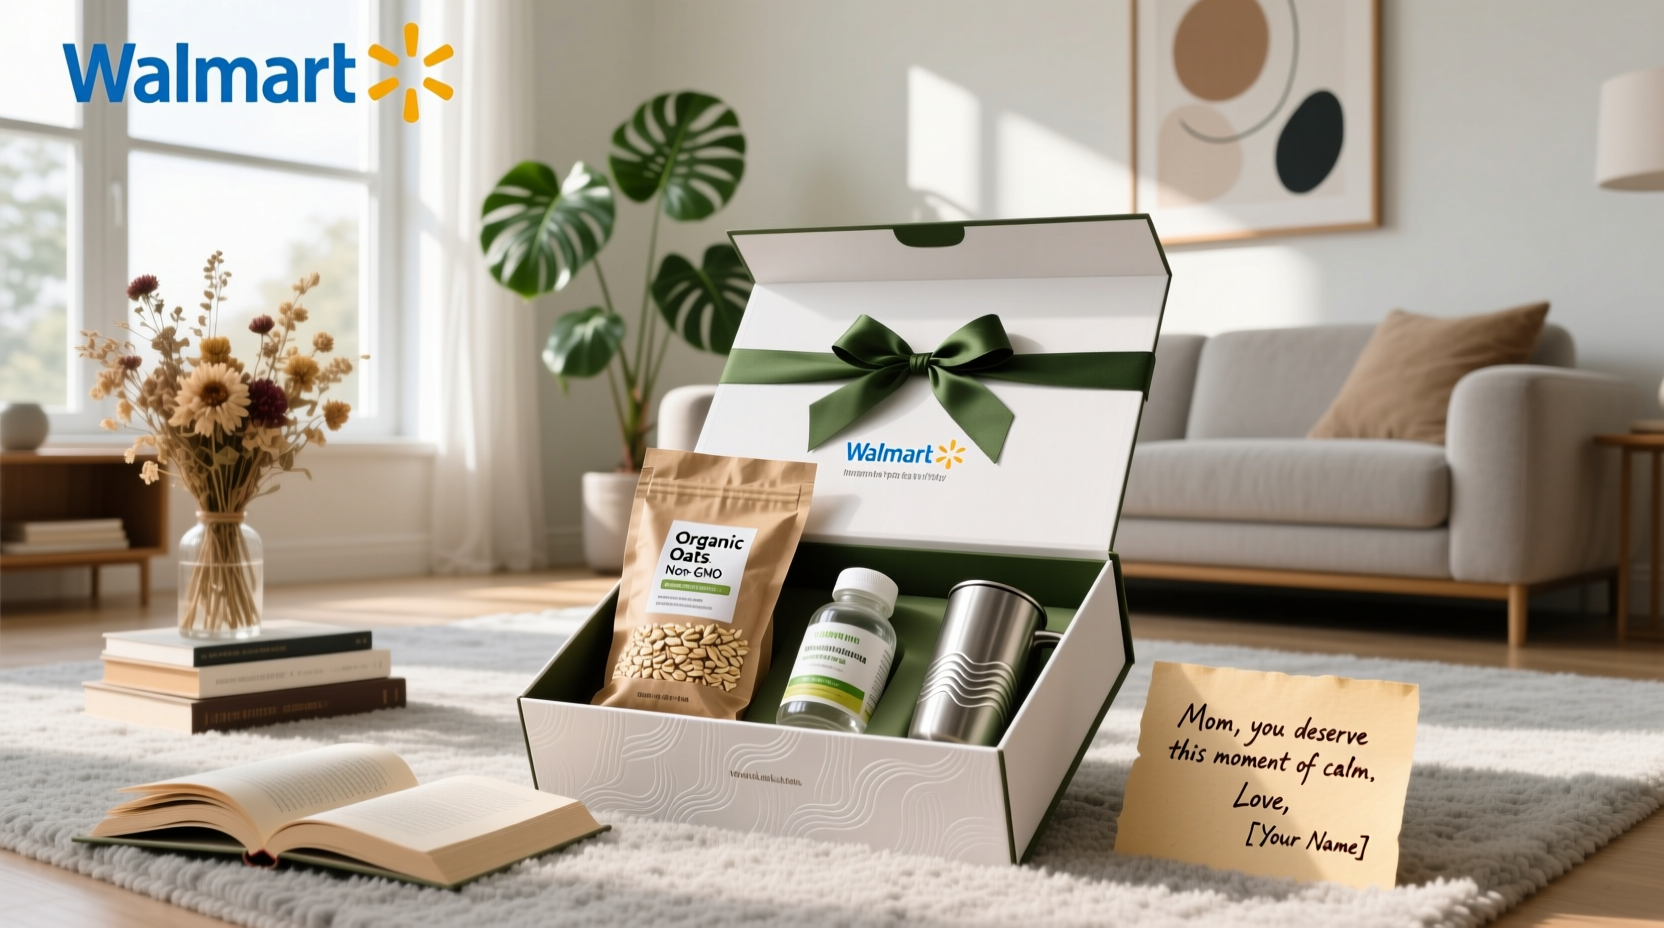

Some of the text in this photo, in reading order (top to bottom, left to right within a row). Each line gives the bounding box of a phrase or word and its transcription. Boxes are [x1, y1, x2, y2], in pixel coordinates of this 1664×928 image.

[847, 441, 934, 464] Walmart
[675, 531, 744, 550] Organic
[1177, 703, 1369, 747] Mom, you deserve
[1168, 738, 1207, 764] this
[1213, 751, 1291, 773] moment
[1296, 752, 1320, 786] of
[1233, 781, 1289, 815] Love,
[1245, 821, 1370, 861] [Your Name]
